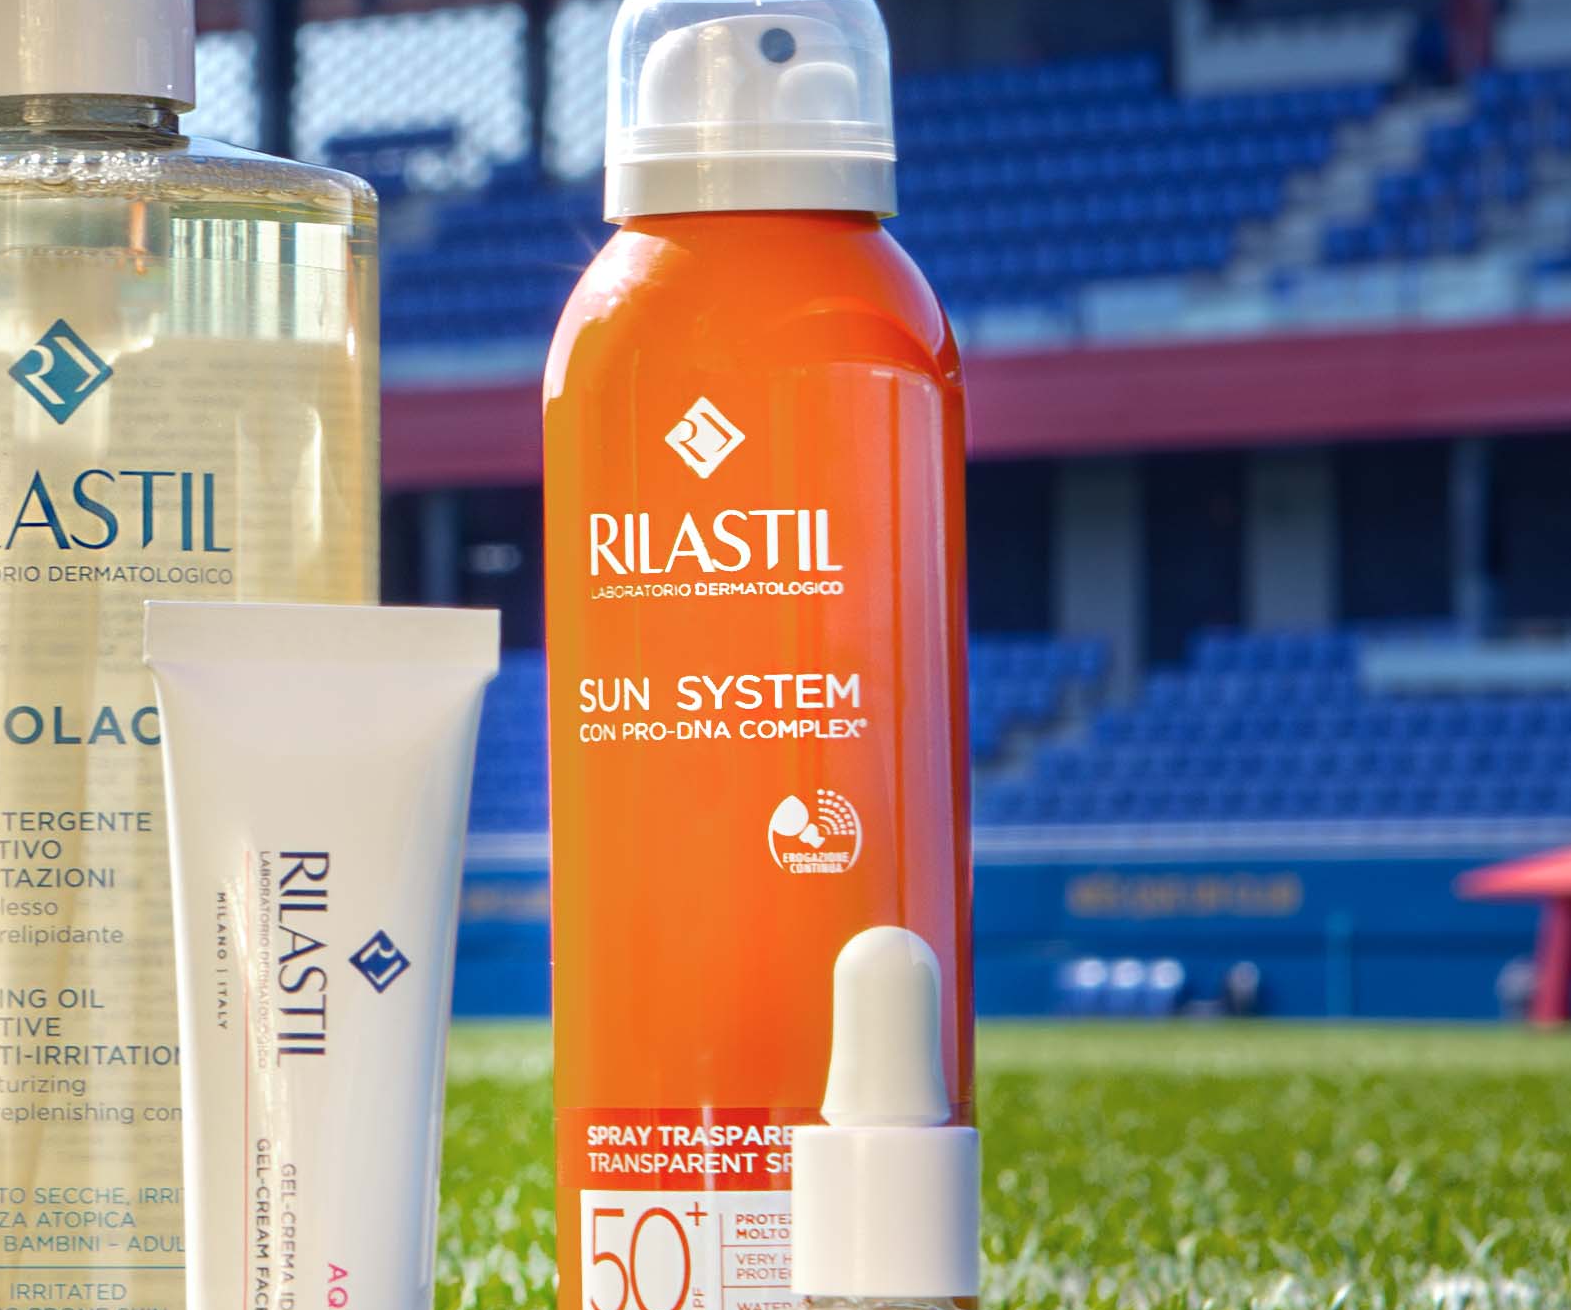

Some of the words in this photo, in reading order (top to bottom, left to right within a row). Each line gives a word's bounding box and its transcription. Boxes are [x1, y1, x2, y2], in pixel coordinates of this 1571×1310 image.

[589, 509, 843, 576] RILASTIL
[49, 566, 233, 585] DERMATOLOGICO
[591, 583, 691, 599] LABORATORIO
[695, 581, 844, 596] DERMATOLOGICO
[579, 677, 650, 713] SUN
[676, 673, 861, 711] SYSTEM
[579, 723, 617, 743] CON
[622, 720, 731, 741] PRO-DNA
[258, 851, 271, 947] LABORATORIO
[217, 892, 227, 960] MILANO
[277, 851, 330, 1067] RILASTIL
[57, 989, 105, 1009] OIL
[217, 982, 227, 1029] ITALY
[587, 1126, 652, 1146] SPRAY
[587, 1152, 759, 1174] TRANSPARENT
[34, 1187, 130, 1206] SECCHE,
[255, 1138, 271, 1258] GEL-CREAM
[36, 1212, 137, 1228] ATOPICA
[280, 1163, 296, 1283] GEL-CREMA
[4, 1236, 100, 1252] BAMBINI
[735, 1228, 790, 1240] MOLTO
[735, 1253, 777, 1265] VERY
[10, 1284, 127, 1300] IRRITATED
